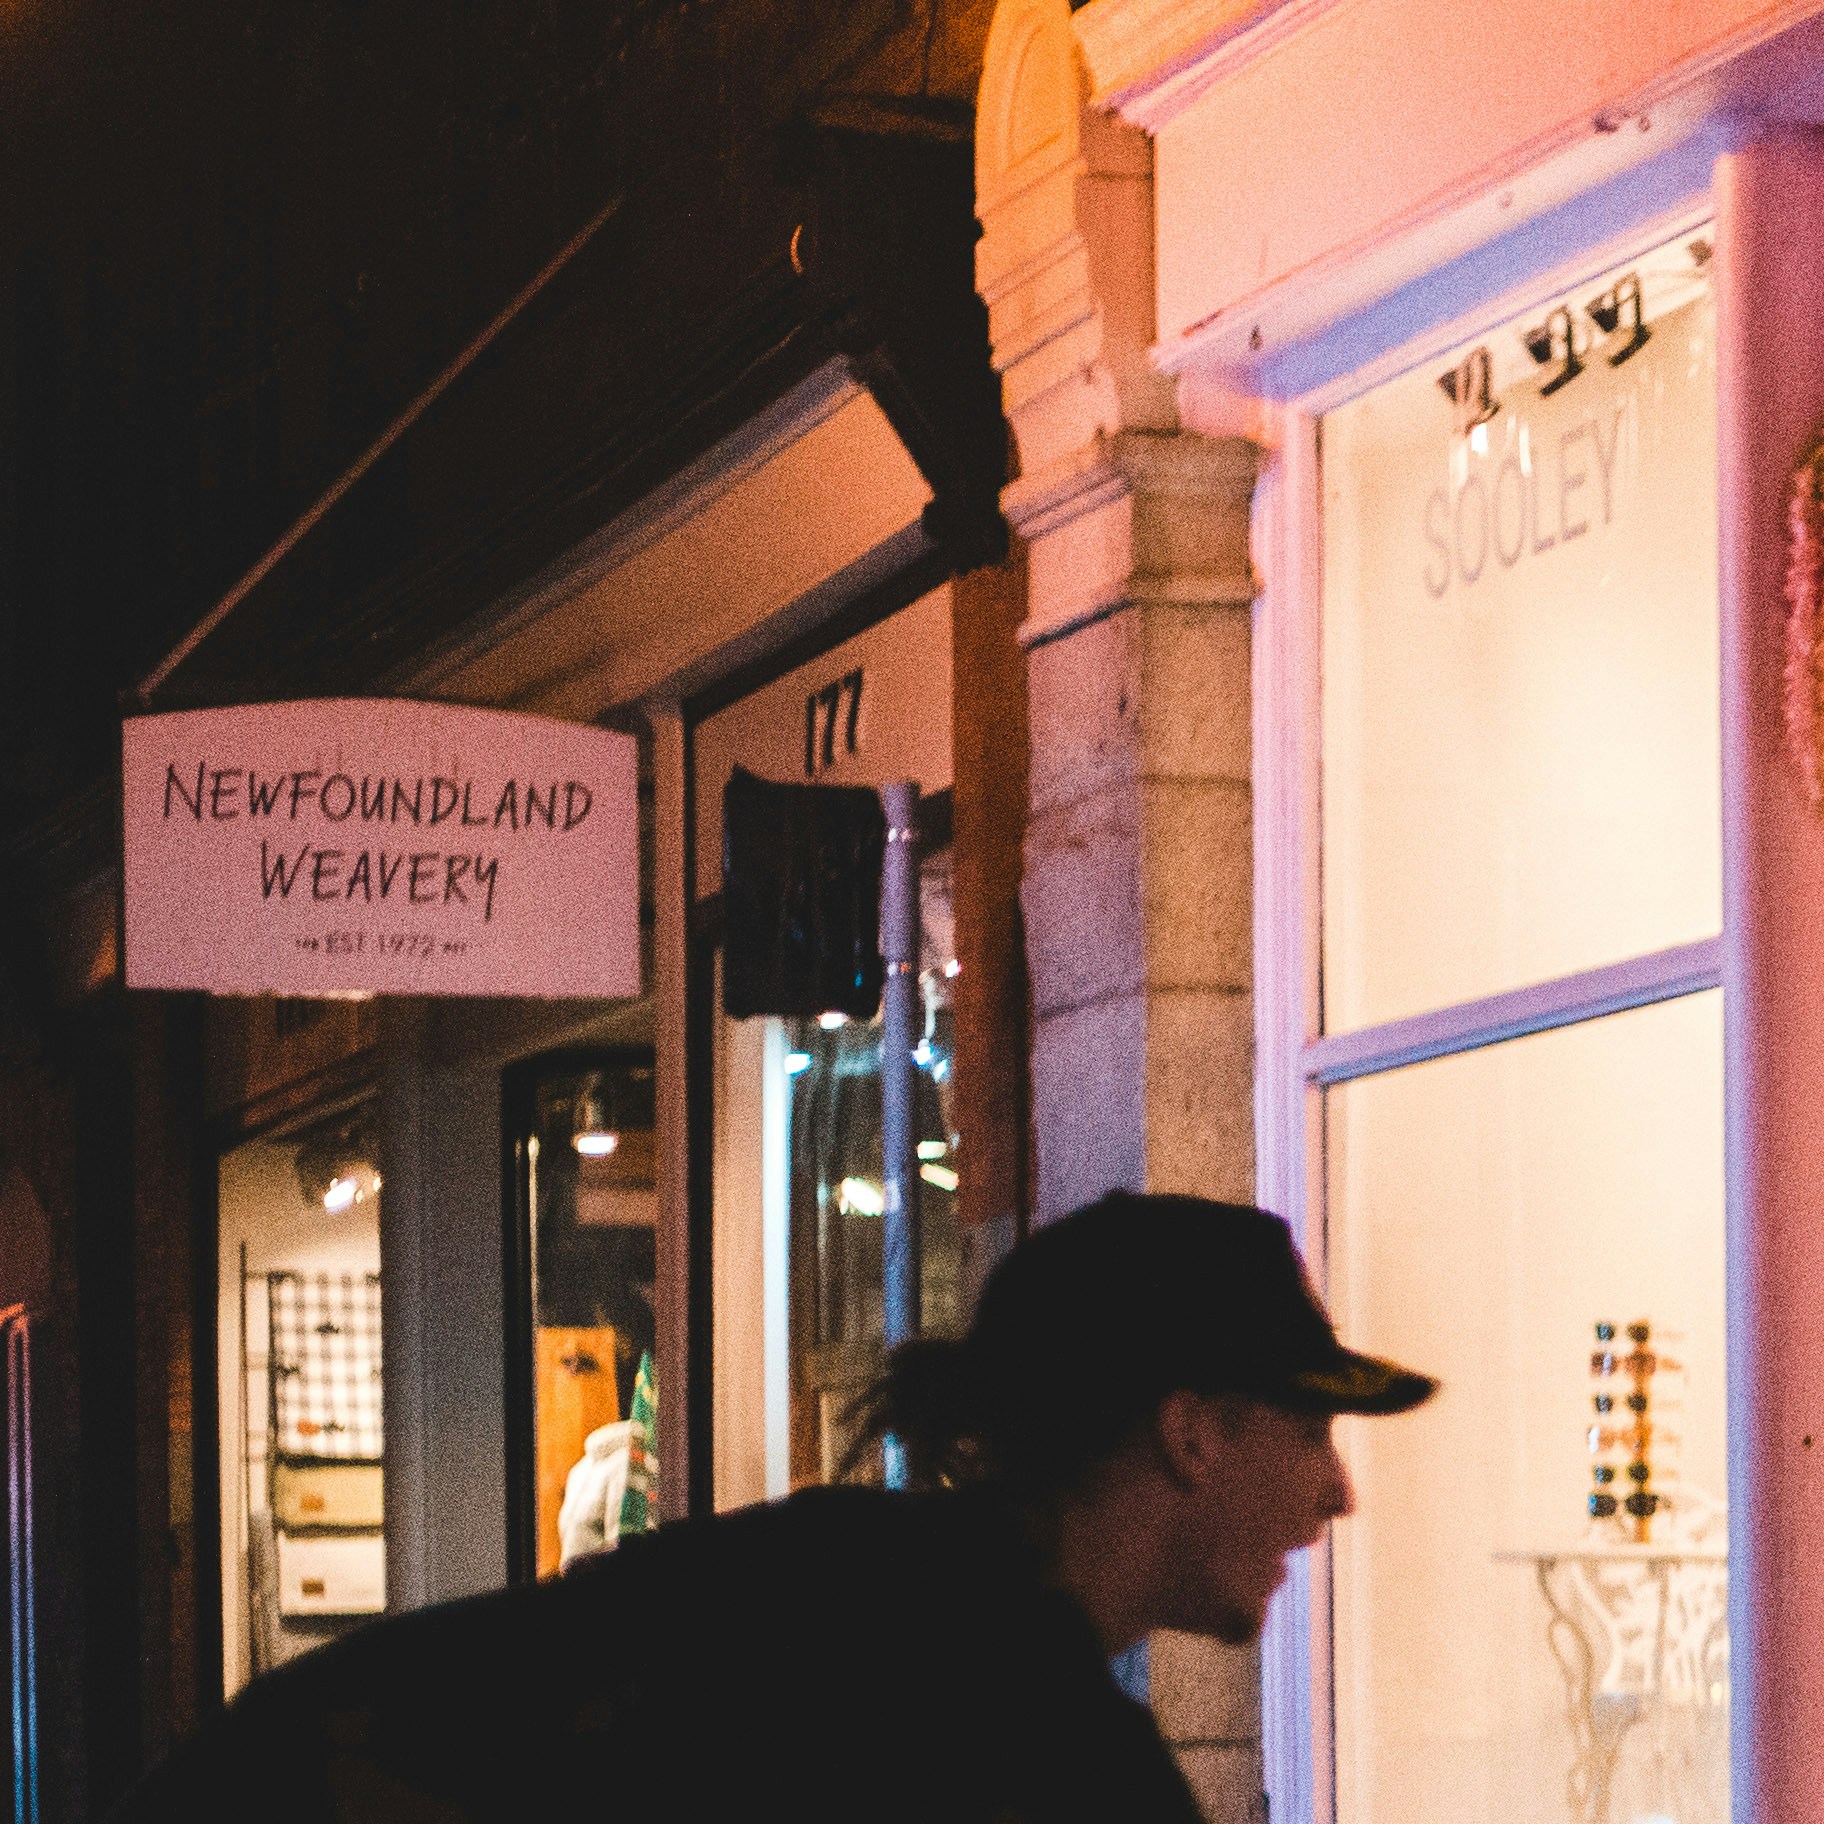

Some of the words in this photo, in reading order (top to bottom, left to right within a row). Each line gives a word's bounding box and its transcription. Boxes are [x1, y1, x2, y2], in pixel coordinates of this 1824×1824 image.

[1423, 406, 1627, 601] SOOLEY
[805, 664, 864, 777] 177
[161, 760, 594, 831] NEWFOUNDLAND
[260, 840, 500, 922] WEAVERY
